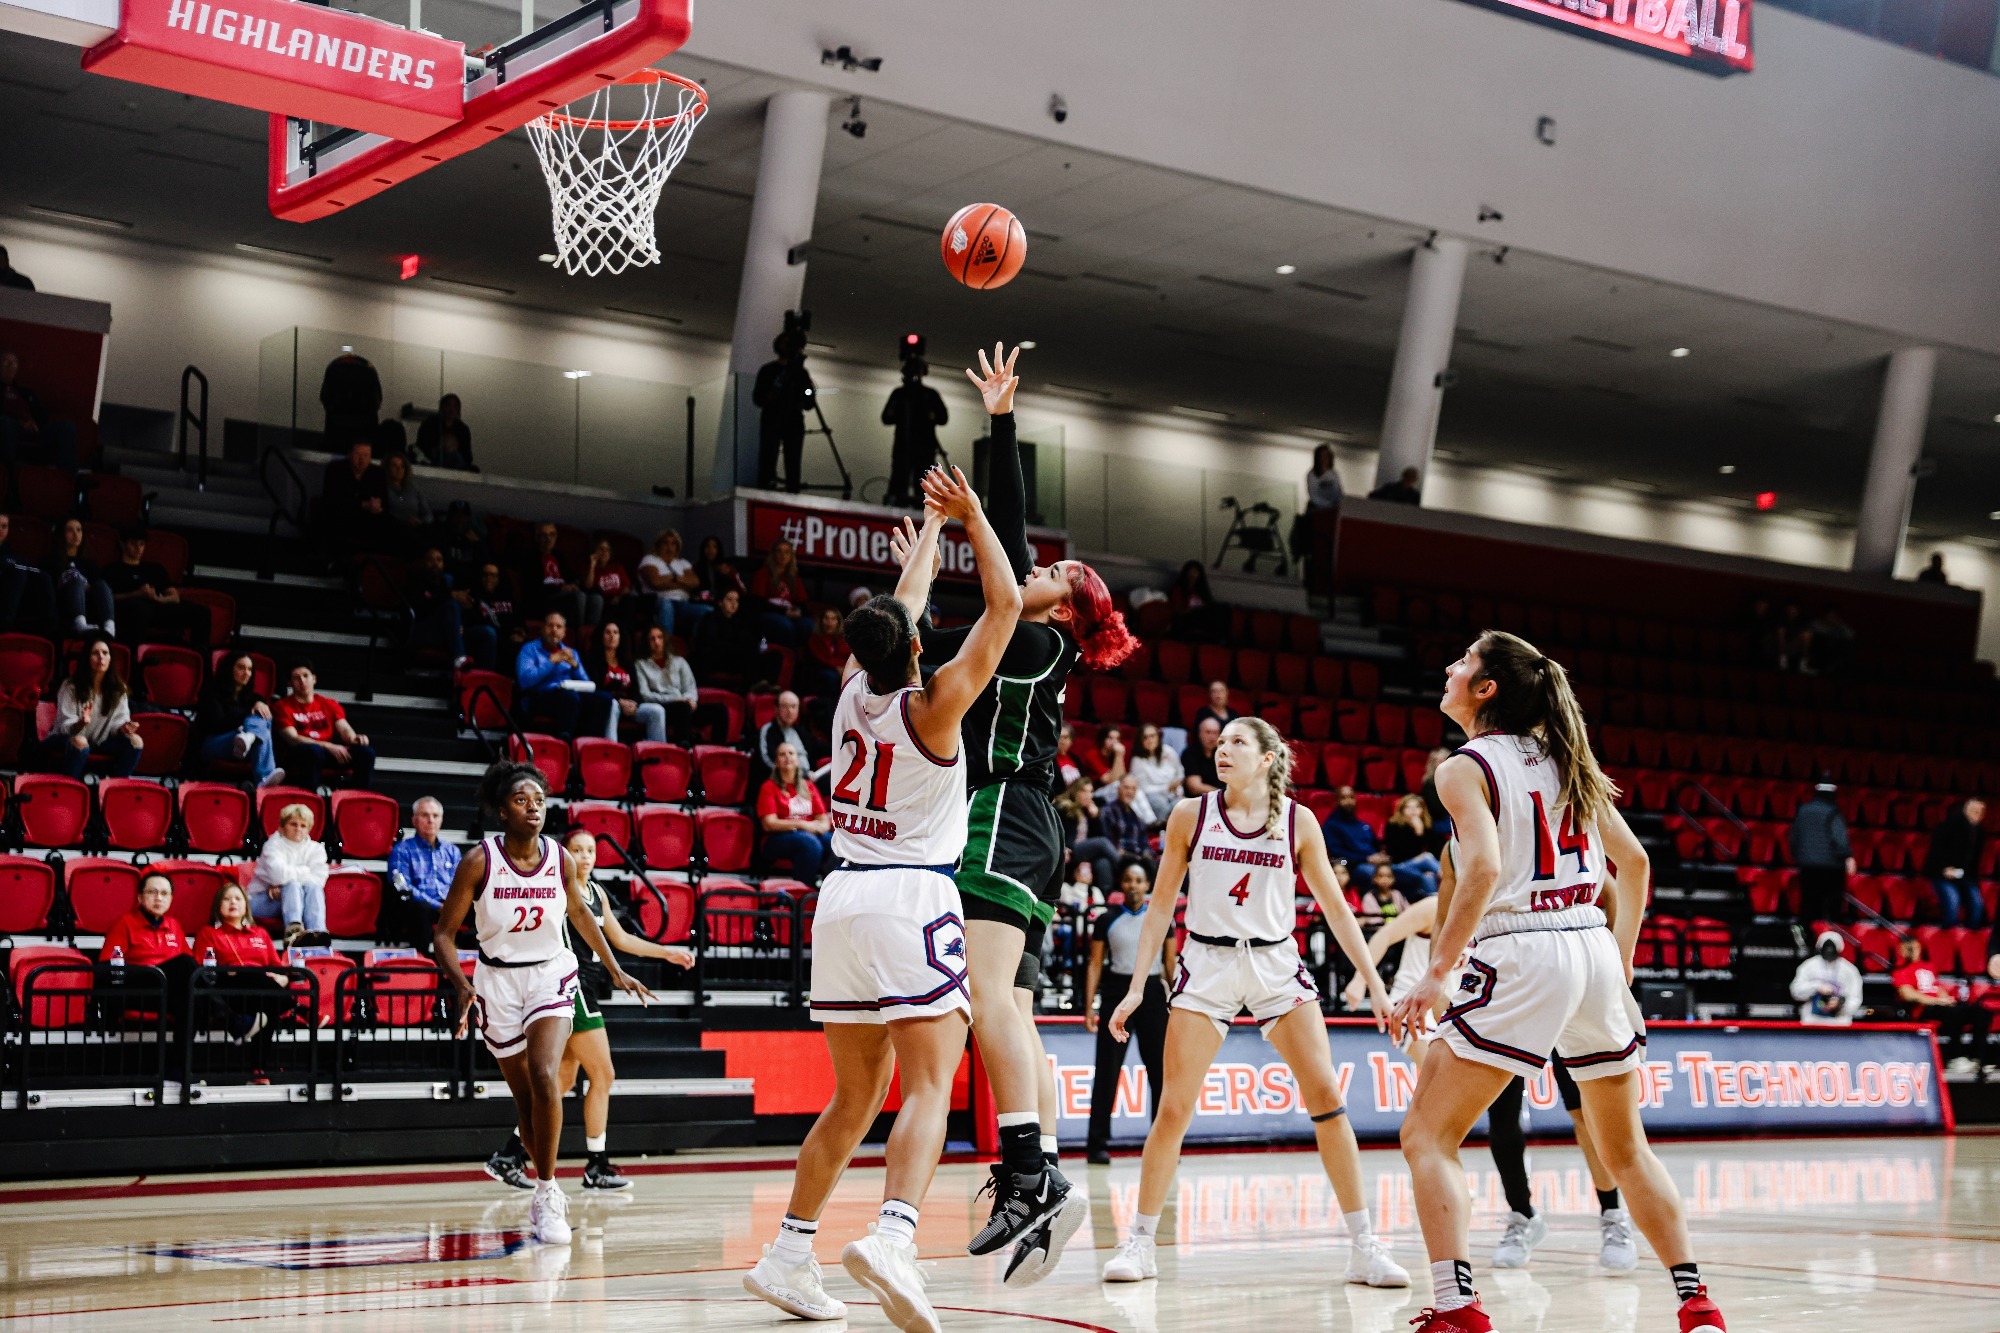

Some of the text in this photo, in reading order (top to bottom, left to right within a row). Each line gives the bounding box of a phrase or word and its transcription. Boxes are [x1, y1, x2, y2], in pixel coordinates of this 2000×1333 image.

[168, 0, 435, 90] HIGHLANDERS
[832, 729, 896, 813] 21
[1202, 845, 1285, 869] HIGHLANDERS
[1528, 790, 1590, 882] 14
[493, 887, 557, 899] HIGHLANDERS
[1228, 872, 1251, 906] 4
[508, 905, 545, 933] 23
[1046, 1053, 1148, 1119] EW
[1676, 1051, 1932, 1107] TECHNOLOGY
